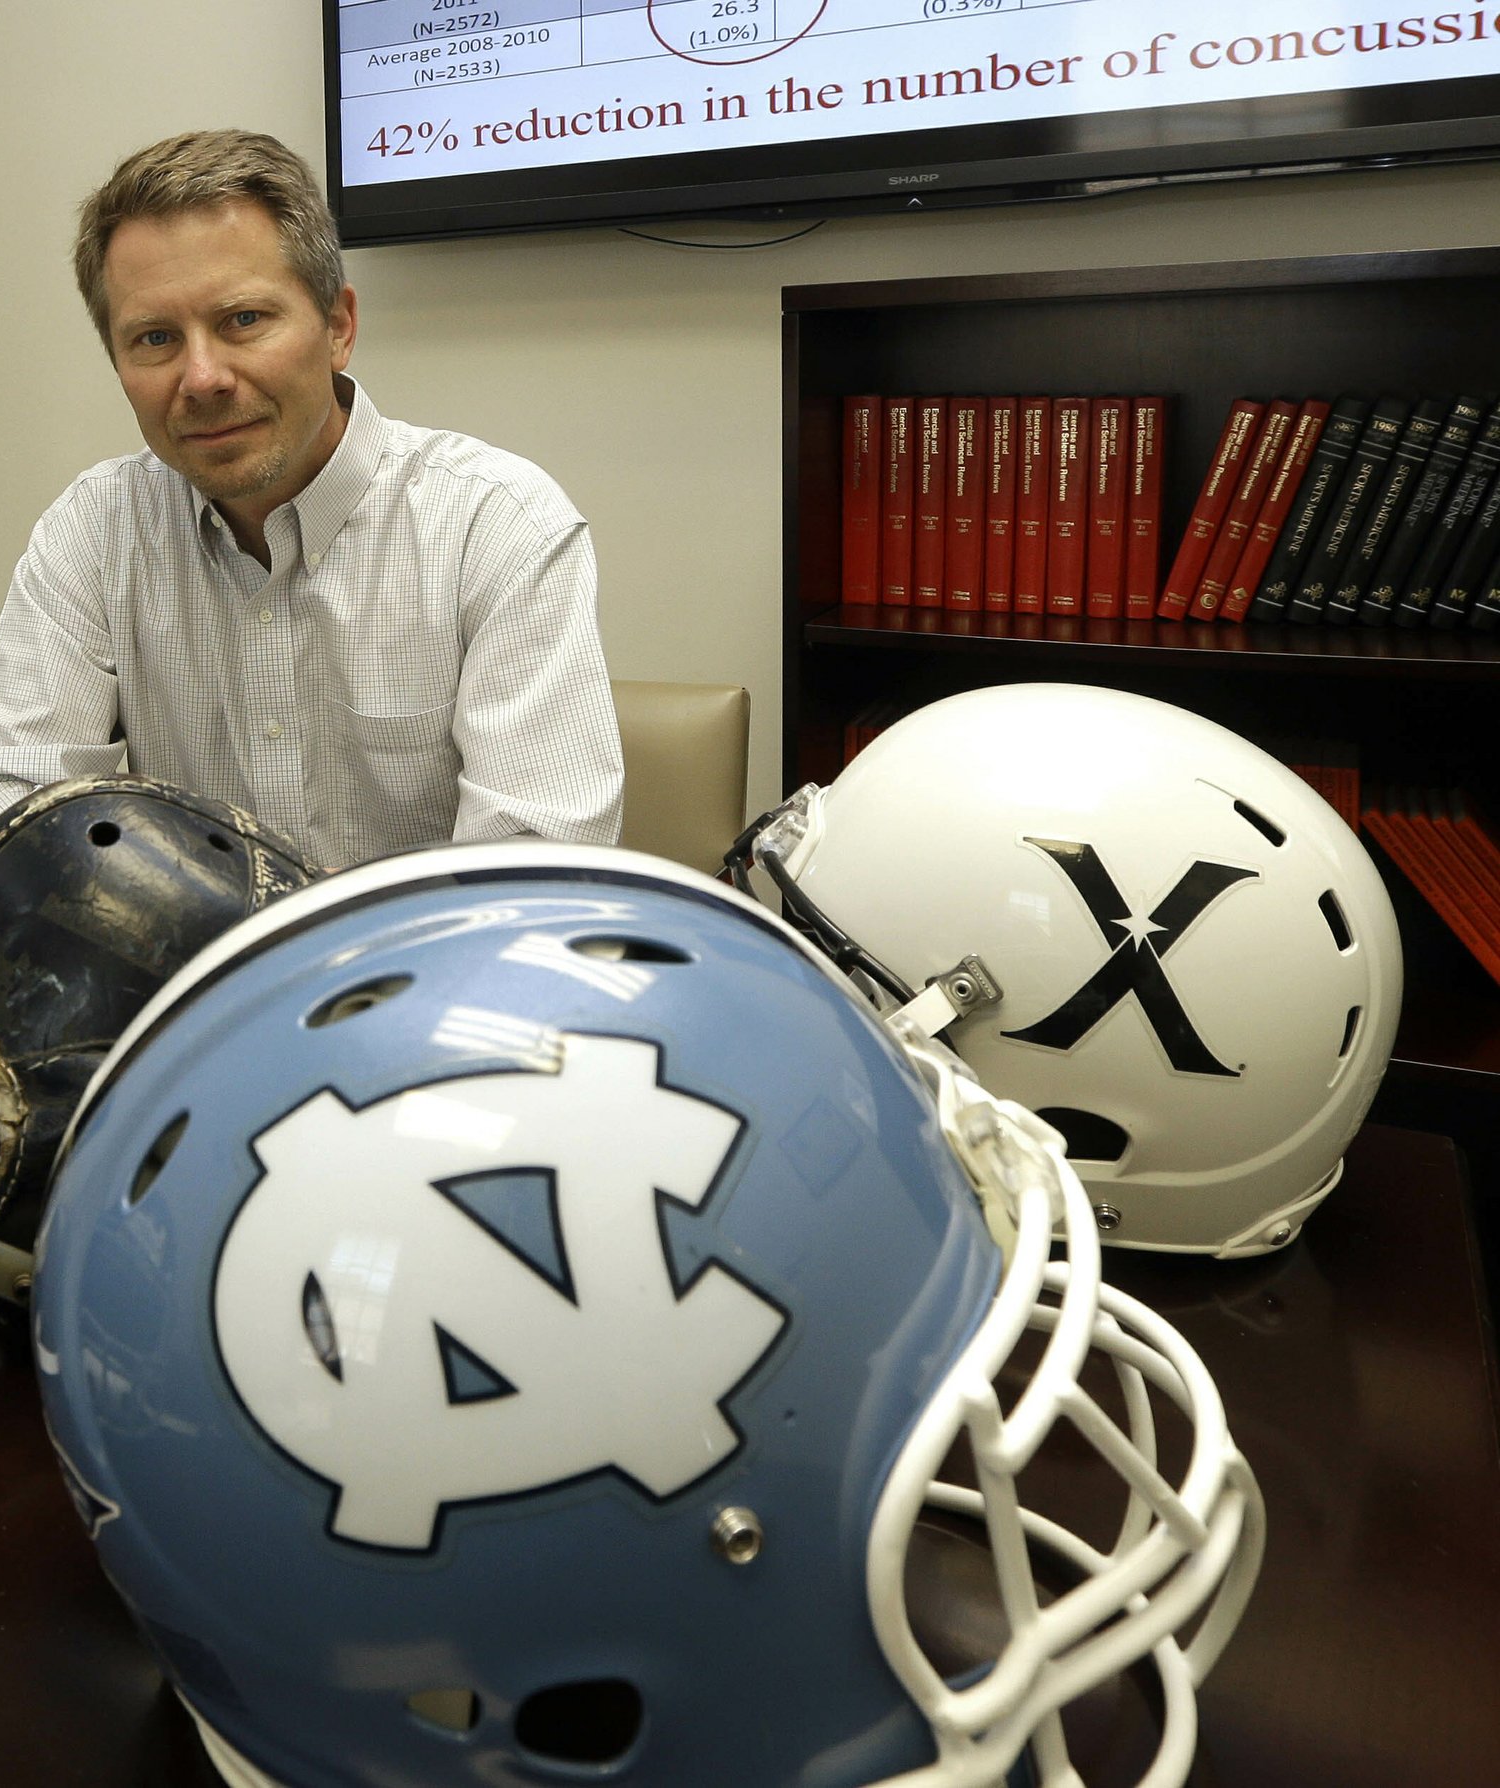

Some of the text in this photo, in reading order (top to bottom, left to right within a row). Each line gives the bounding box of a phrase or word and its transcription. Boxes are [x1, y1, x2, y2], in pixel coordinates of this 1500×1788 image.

[711, 0, 760, 18] 26.3
[412, 10, 500, 40] (N=2572)
[689, 22, 759, 50] (1.0%)
[366, 28, 551, 68] Average 2008-2010
[366, 0, 1500, 158] 42% reduction in the number of concussi
[413, 58, 502, 87] (N=2533)
[888, 173, 940, 186] SHARP
[890, 408, 898, 428] Sport
[899, 408, 908, 438] Exercise
[922, 408, 931, 428] Sport
[931, 408, 940, 438] Exercise
[958, 410, 966, 430] Sport
[993, 410, 1002, 430] Sport
[1024, 410, 1034, 430] Sport
[1100, 408, 1110, 428] Sport
[1136, 408, 1146, 428] Sport
[1230, 411, 1246, 432] Sport
[1266, 414, 1281, 434] Sport
[1296, 414, 1312, 437] Sport
[1372, 420, 1398, 434] 1986
[966, 410, 976, 456] Exercise and
[1002, 410, 1010, 455] Exercise and
[1033, 410, 1042, 456] Exercise and
[1070, 410, 1079, 460] Exercise and
[1058, 410, 1070, 502] Sport Sciences Reviews
[1109, 440, 1117, 456] and
[1310, 464, 1334, 503] SPORTS
[1348, 464, 1373, 504] SPORTS
[1384, 464, 1410, 504] SPORTS
